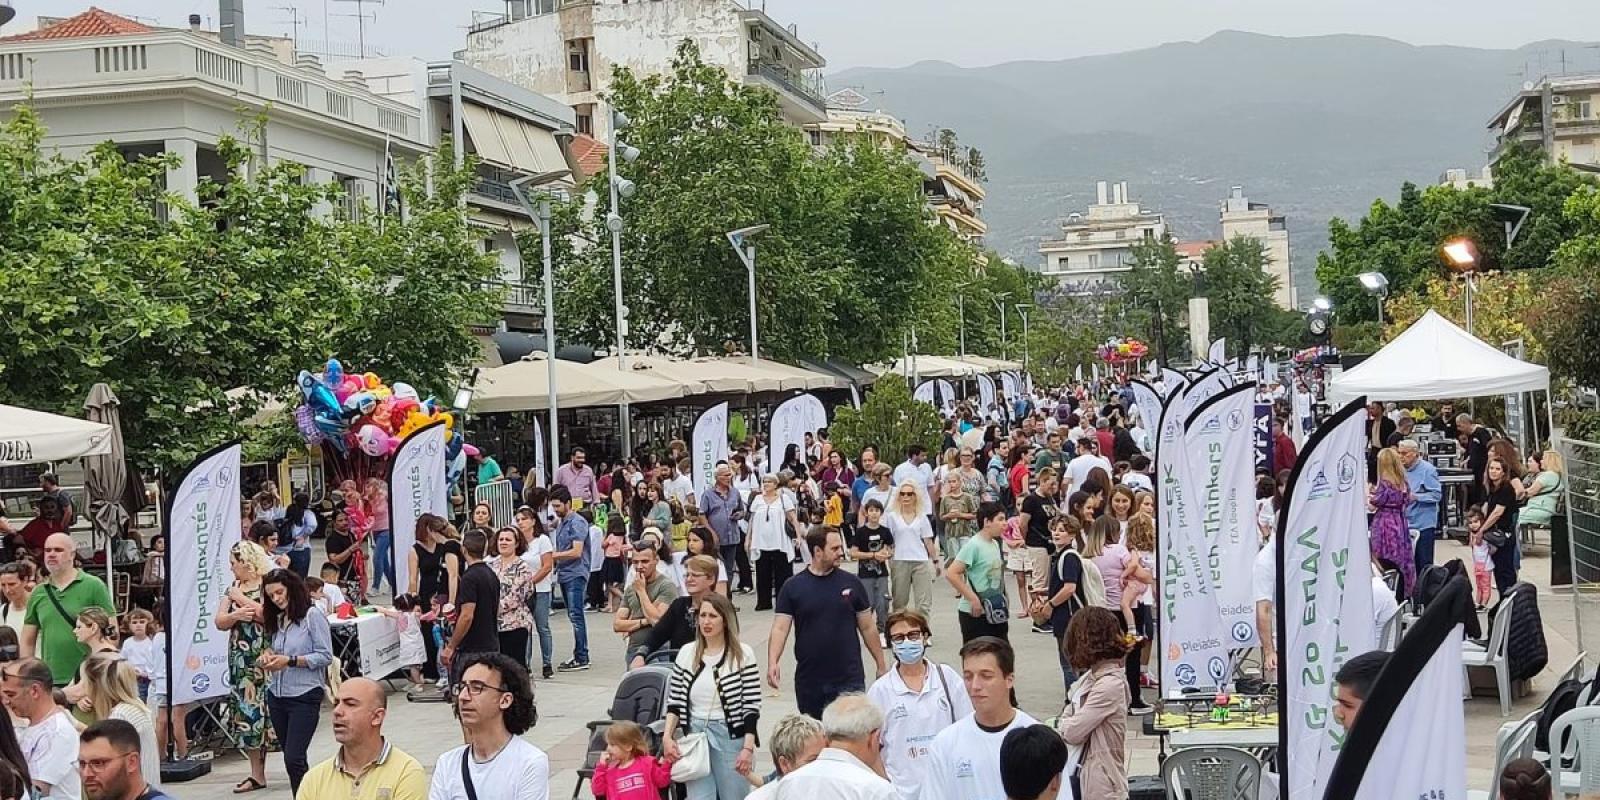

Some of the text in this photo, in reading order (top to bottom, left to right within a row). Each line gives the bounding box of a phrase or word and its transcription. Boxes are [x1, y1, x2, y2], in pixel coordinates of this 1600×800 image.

[407, 465, 421, 518] αχητές
[1203, 442, 1221, 538] Thinkers
[1218, 603, 1254, 616] leiades
[1181, 637, 1221, 654] Pleiades
[202, 654, 228, 666] Pleia
